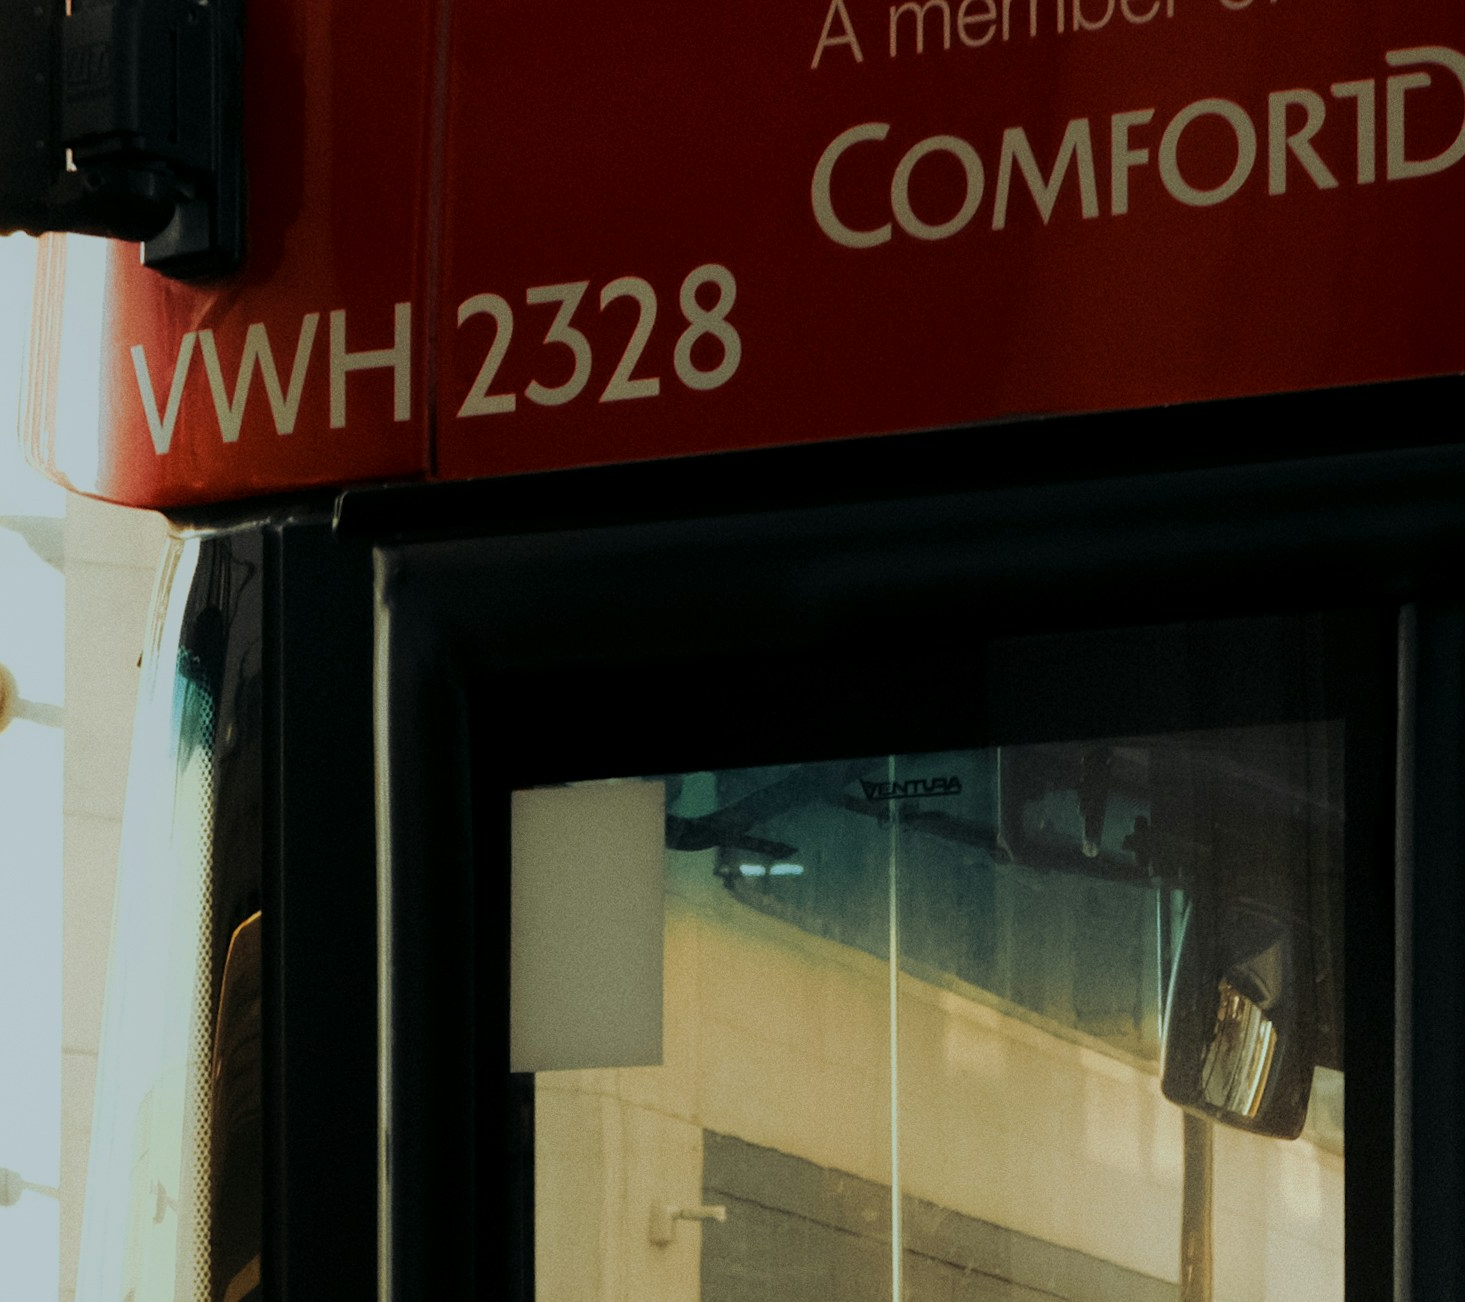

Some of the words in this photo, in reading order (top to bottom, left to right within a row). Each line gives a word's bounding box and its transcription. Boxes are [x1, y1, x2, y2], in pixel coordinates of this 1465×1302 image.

[809, 0, 864, 69] A
[129, 302, 412, 456] VWH
[455, 262, 742, 419] 2328
[859, 775, 962, 800] VENTURA
